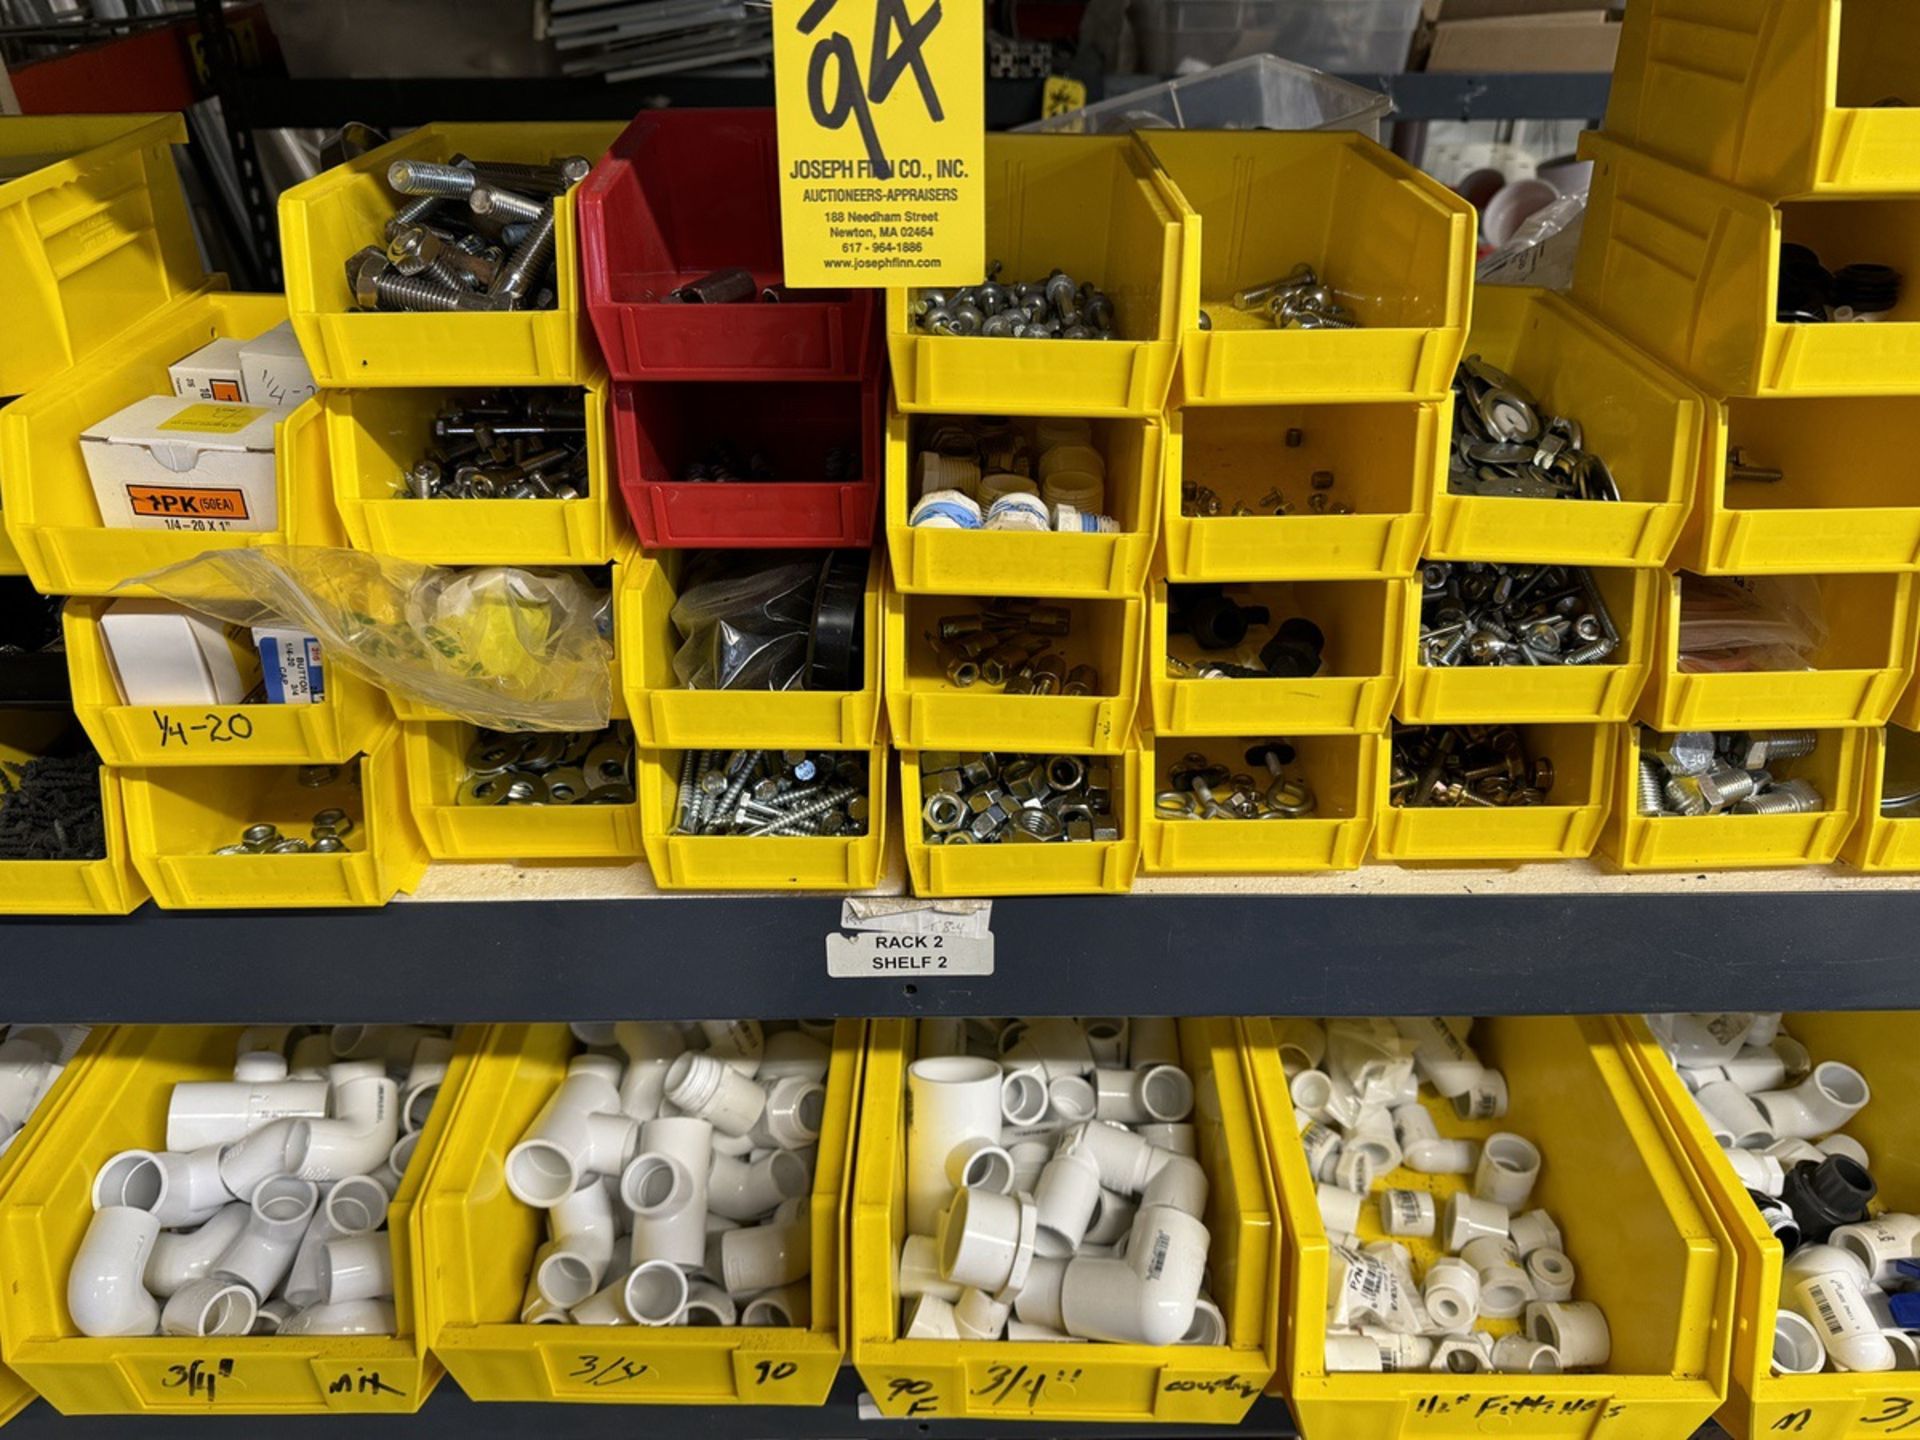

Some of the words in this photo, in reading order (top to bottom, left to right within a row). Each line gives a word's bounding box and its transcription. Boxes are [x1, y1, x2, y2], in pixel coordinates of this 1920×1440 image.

[789, 159, 853, 179] JOSEPH
[857, 159, 894, 179] FIN
[899, 159, 932, 181] CO.,
[937, 159, 968, 178] INC.
[803, 188, 958, 202] AUCTIONEERS-APPRAISERS
[825, 211, 845, 222] 188
[848, 210, 902, 222] Needham
[904, 210, 939, 222] Street
[830, 227, 877, 239] Newton,
[880, 227, 898, 238] MA
[900, 227, 934, 238] 02464
[842, 243, 862, 253] 617
[872, 242, 923, 253] 964-1886
[824, 258, 941, 270] www.josephfinn.com
[199, 497, 234, 512] (50EA)
[165, 519, 205, 532] 1/4-20
[208, 520, 217, 532] X
[285, 642, 295, 668] 1/4-20
[279, 666, 289, 686] CAP
[296, 656, 309, 695] BUTTON
[153, 710, 252, 746] 1/4-20
[875, 936, 928, 948] RACK
[934, 935, 944, 948] 2
[872, 956, 931, 969] SHELF
[938, 956, 948, 968] 2
[888, 1378, 933, 1401] 90
